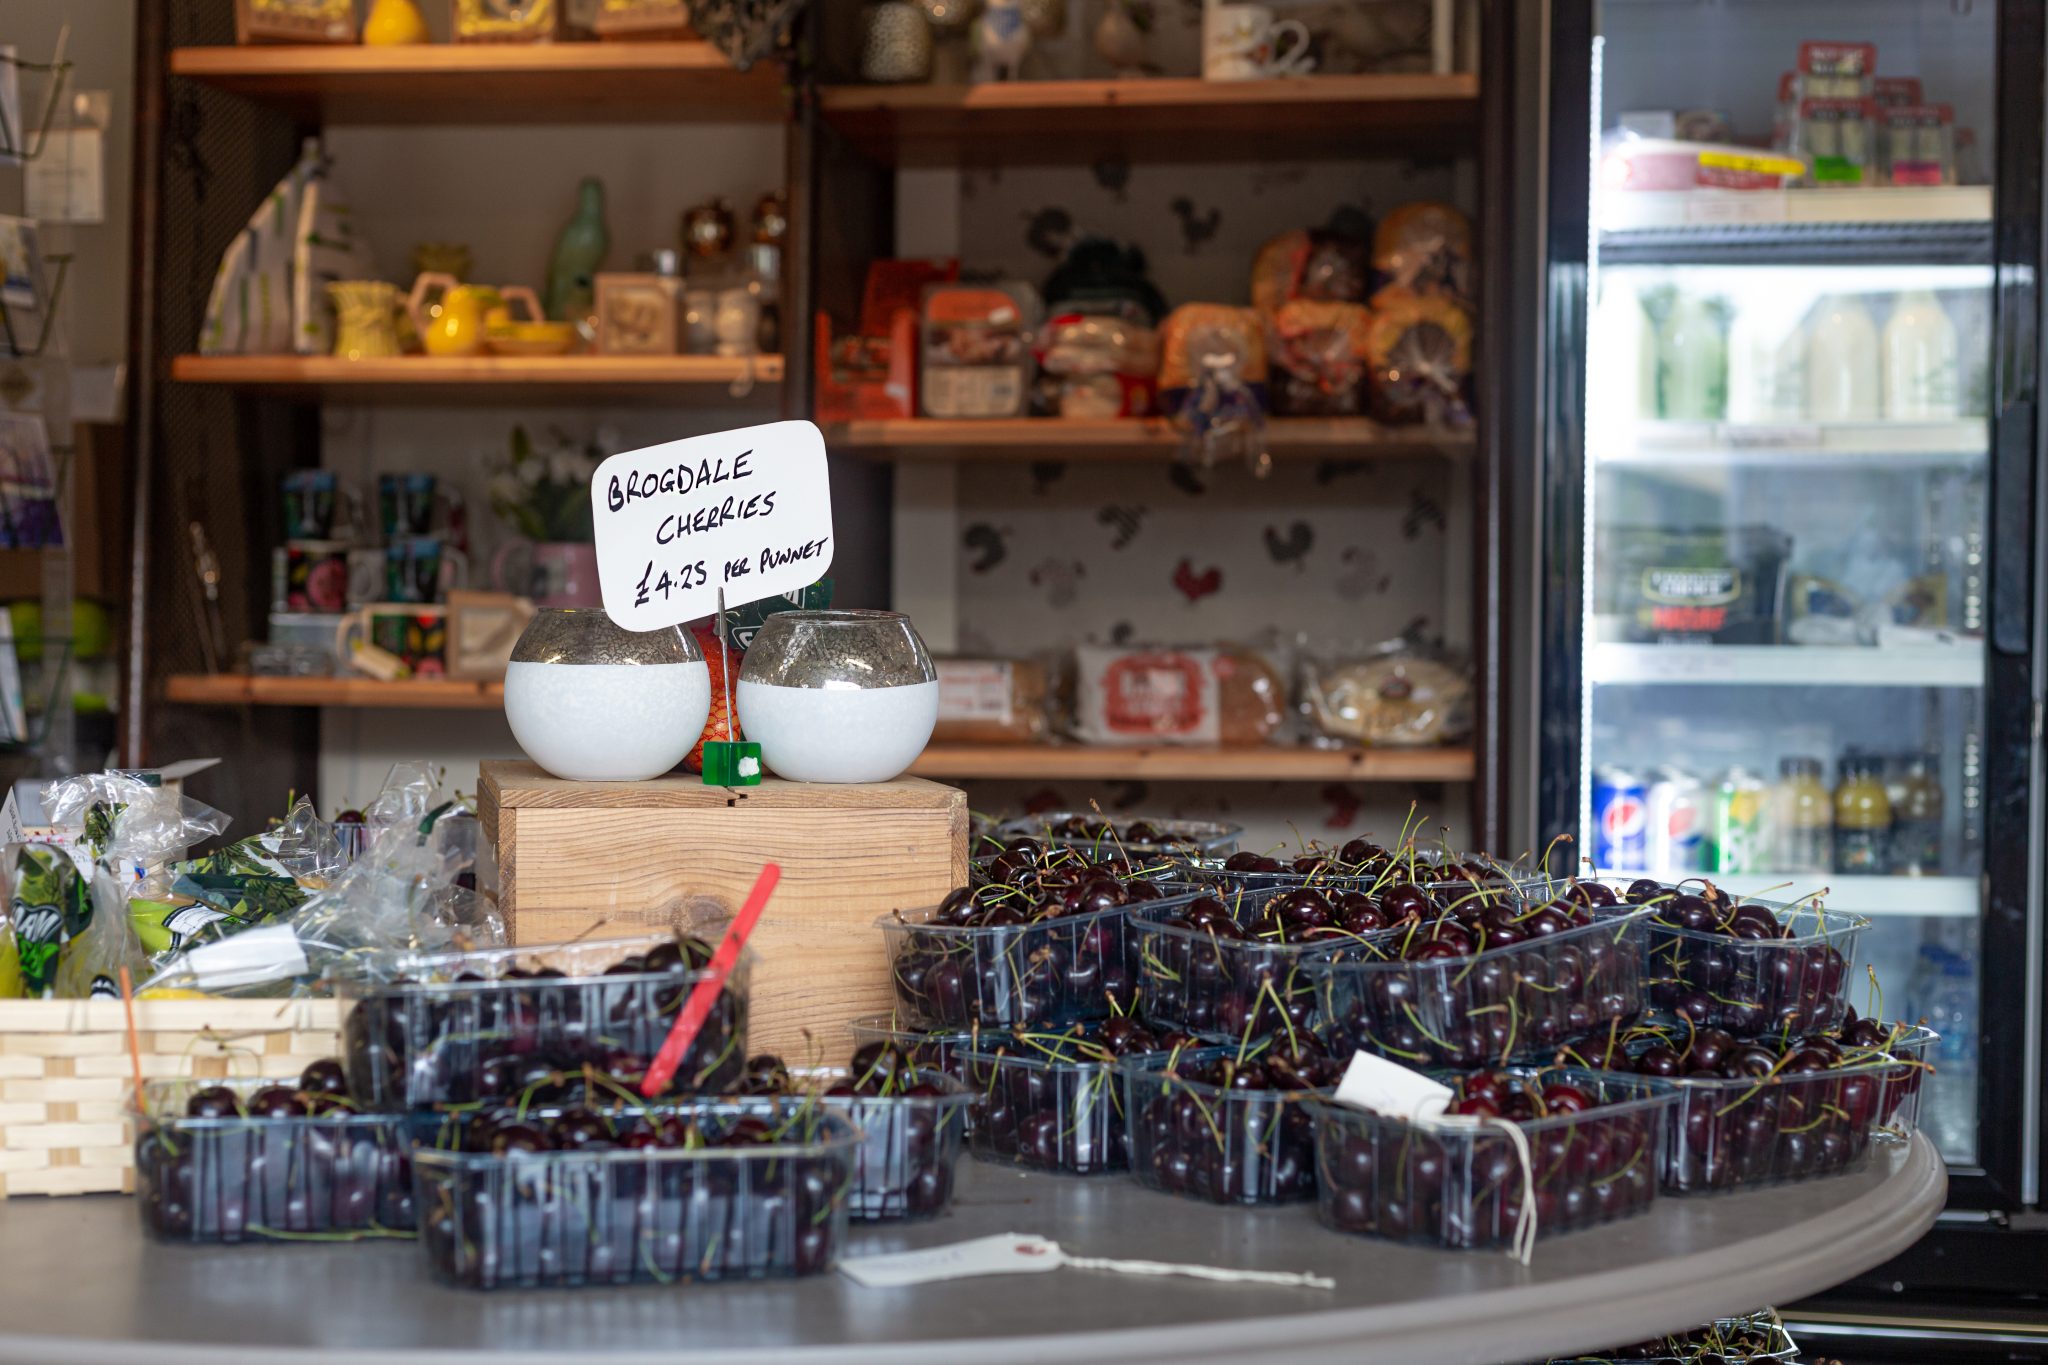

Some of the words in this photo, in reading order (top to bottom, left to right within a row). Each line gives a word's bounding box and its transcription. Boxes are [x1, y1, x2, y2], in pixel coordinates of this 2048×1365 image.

[608, 449, 753, 512] BROGDALE
[656, 491, 777, 544] CHERRIES
[634, 560, 707, 608] £4.25
[724, 557, 750, 582] PER
[760, 537, 828, 574] PUNNET
